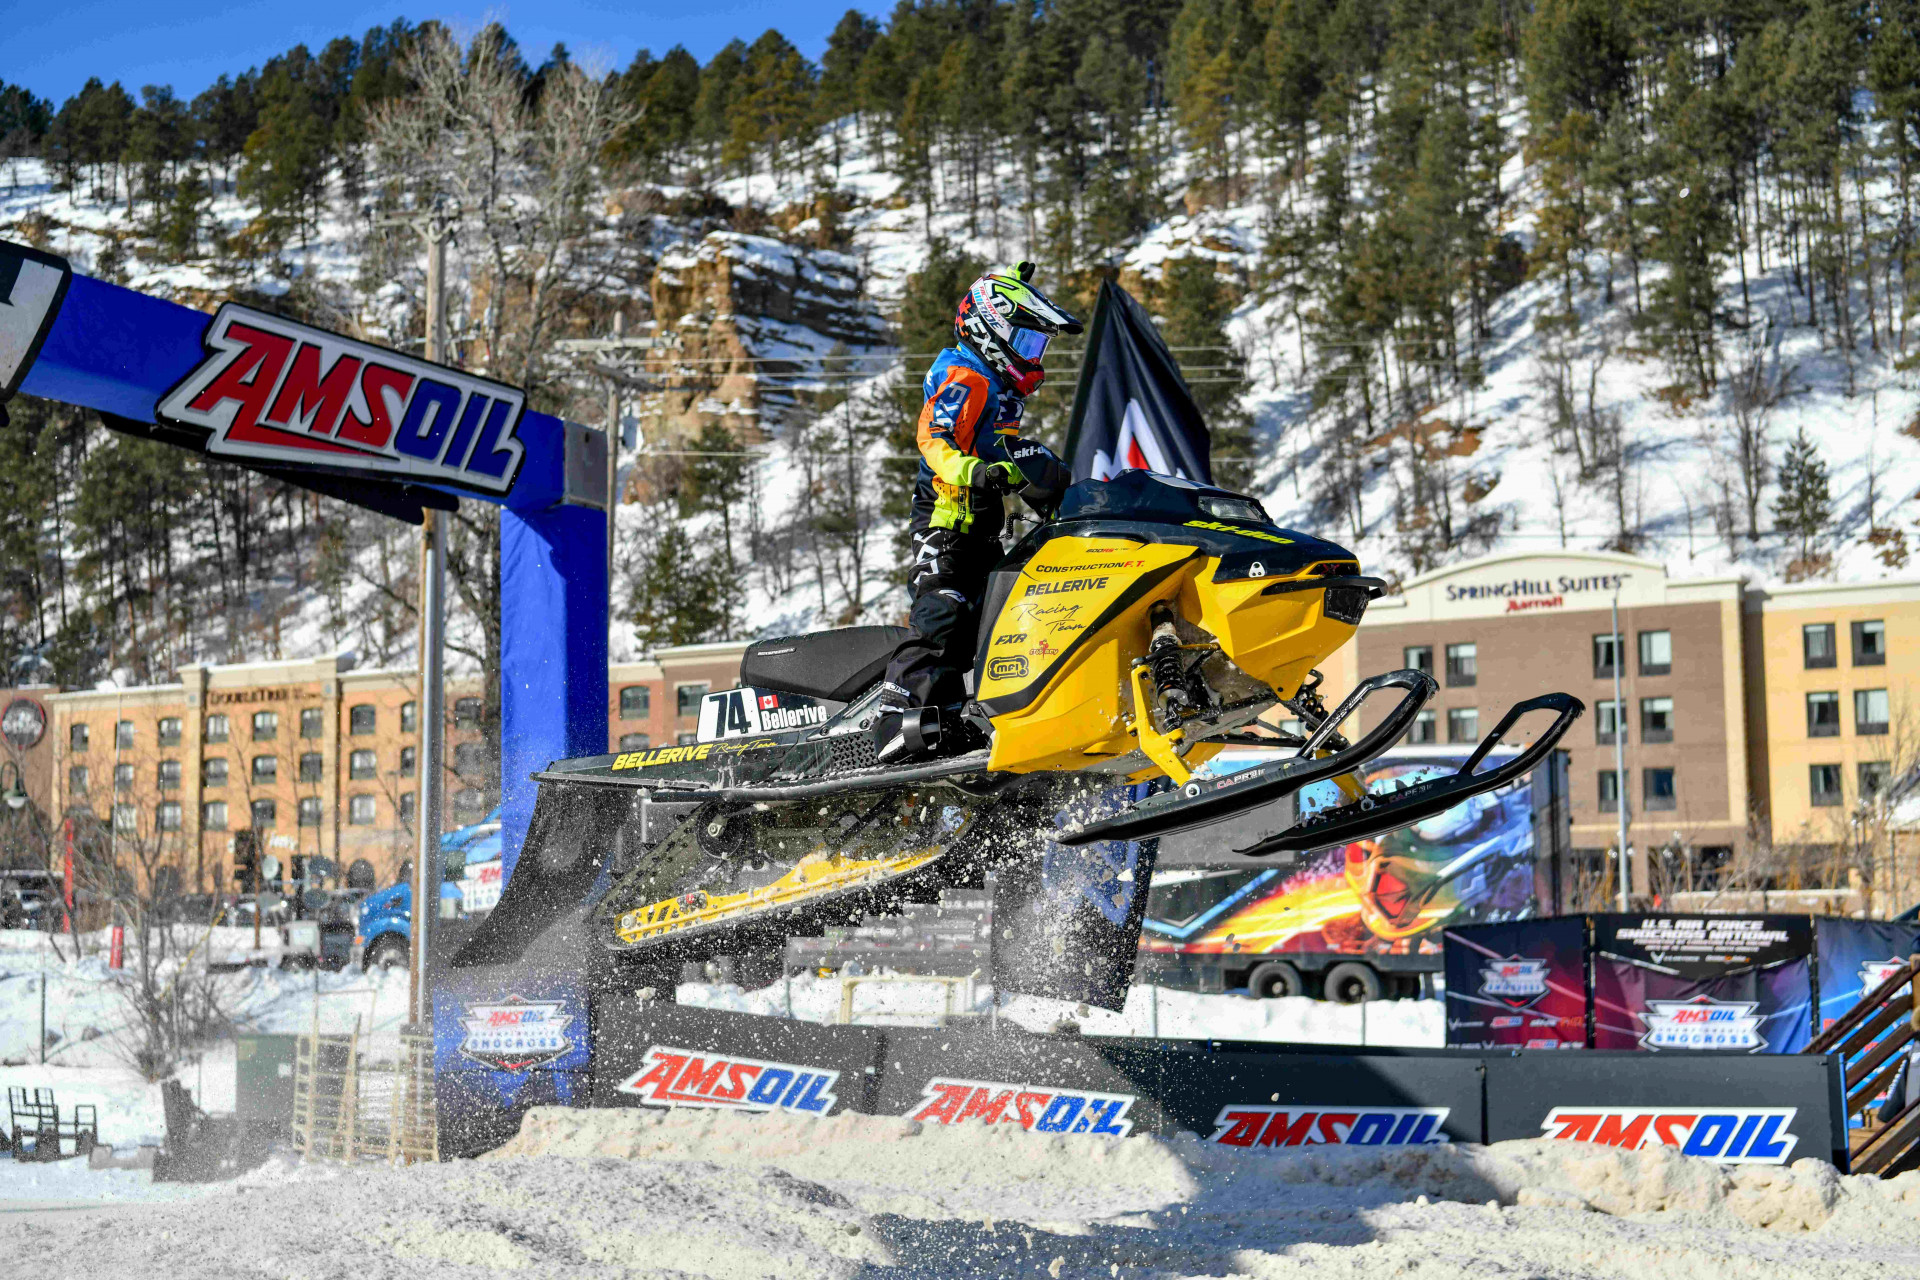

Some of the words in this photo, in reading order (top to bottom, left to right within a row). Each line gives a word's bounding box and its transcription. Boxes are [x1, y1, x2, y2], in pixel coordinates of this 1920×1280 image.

[185, 322, 516, 478] AMSOIL
[1183, 520, 1295, 545] ski-doo
[1024, 577, 1110, 597] BELLERIVE
[1558, 574, 1622, 593] SUITES
[1011, 603, 1083, 621] Racing
[994, 633, 1028, 645] FXR
[1046, 618, 1087, 635] Team
[709, 691, 752, 738] 74
[761, 705, 828, 731] Bellerive
[611, 743, 714, 771] BELLERIVE
[1706, 920, 1764, 931] FORCE
[1672, 1009, 1736, 1023] AMSOIL
[634, 1052, 833, 1112] AMSOIL
[914, 1083, 1132, 1138] AMSOIL
[1217, 1111, 1444, 1146] AMSOIL
[1552, 1114, 1796, 1158] AMSOIL
